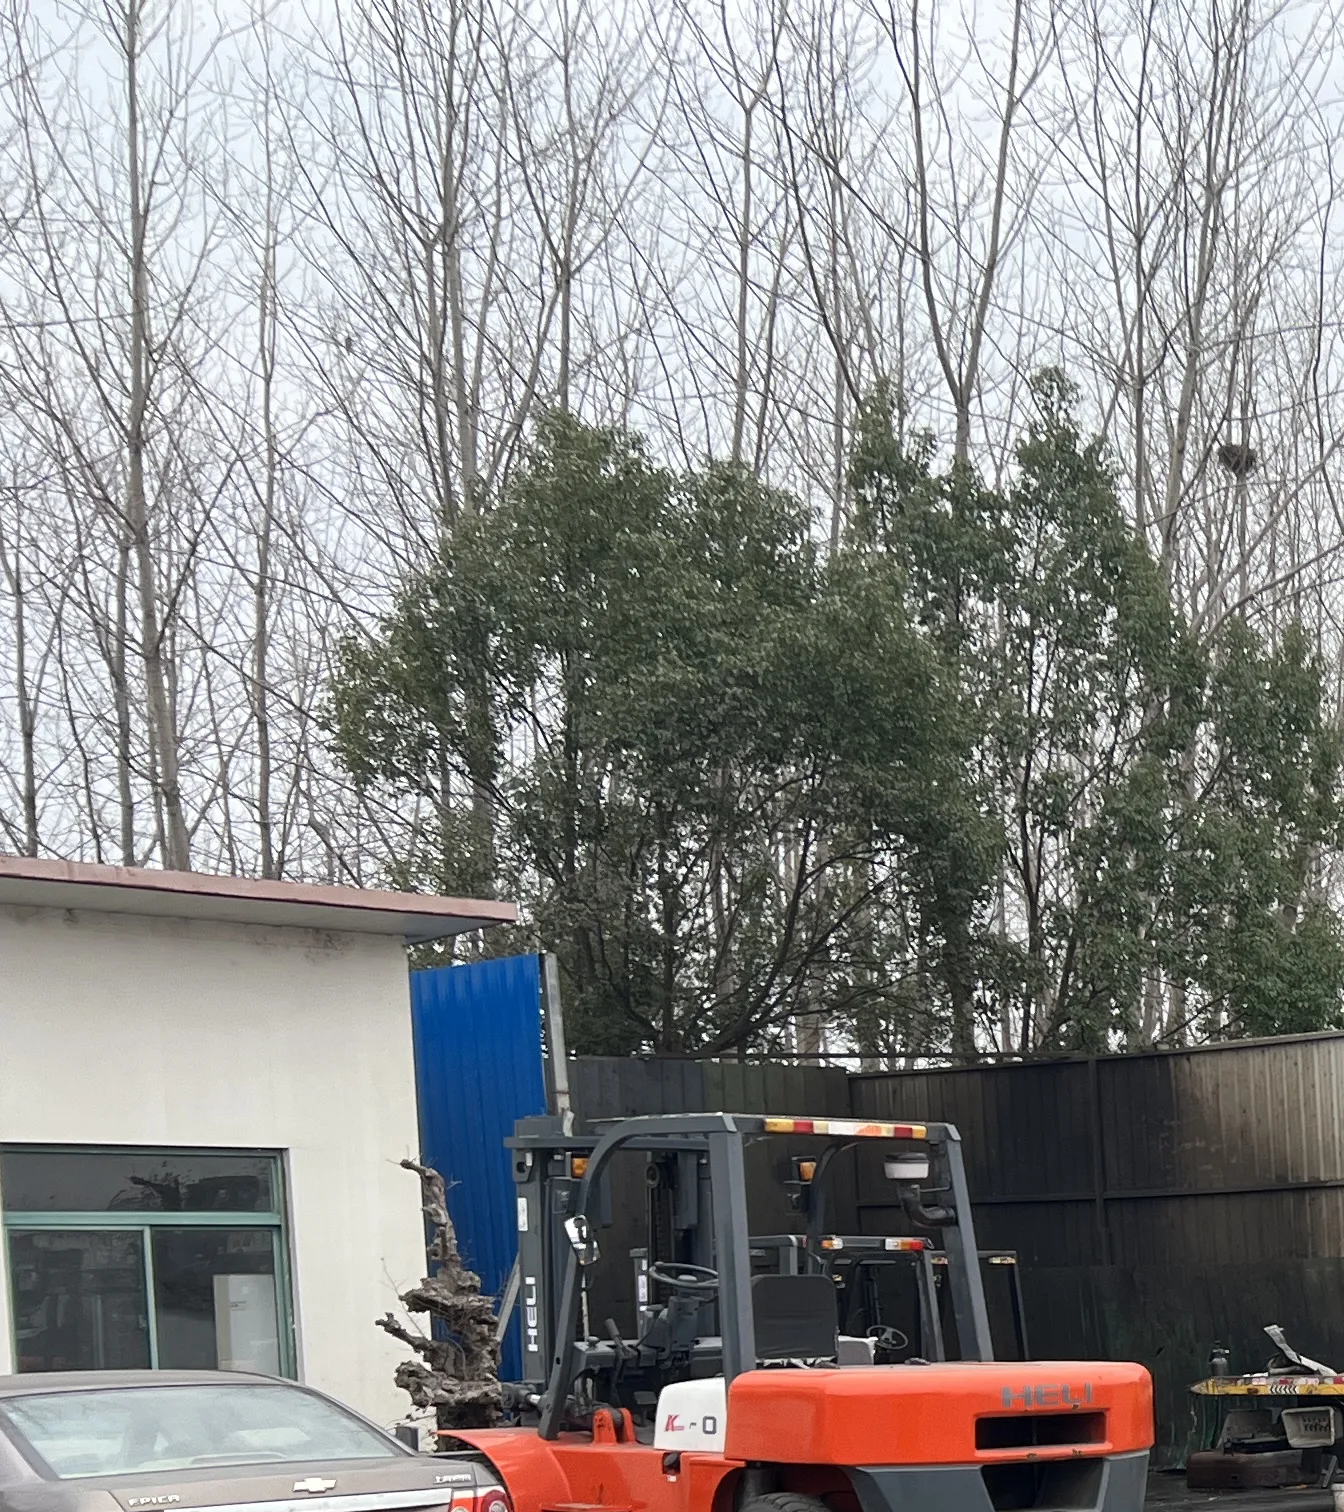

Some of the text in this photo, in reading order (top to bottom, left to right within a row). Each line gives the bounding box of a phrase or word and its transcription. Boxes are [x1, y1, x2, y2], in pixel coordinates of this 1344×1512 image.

[525, 1276, 539, 1352] HELI
[1002, 1382, 1094, 1409] HELI
[128, 1495, 181, 1507] EPICA
